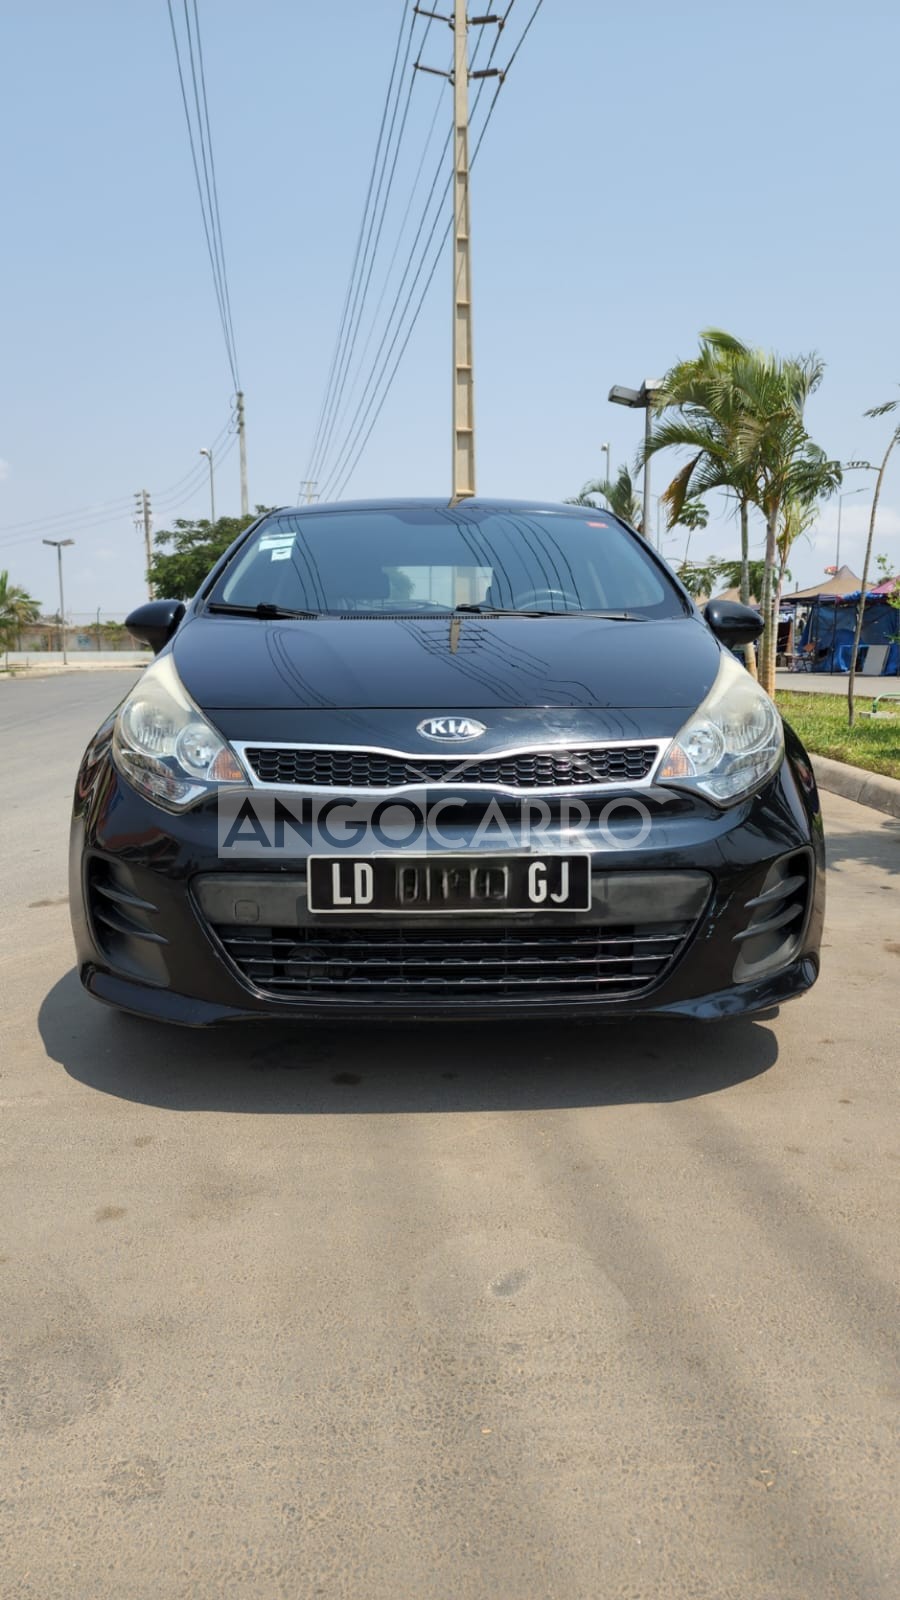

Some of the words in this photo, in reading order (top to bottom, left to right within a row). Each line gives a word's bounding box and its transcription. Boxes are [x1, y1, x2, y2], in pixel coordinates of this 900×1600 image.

[430, 719, 474, 736] KIA
[332, 862, 373, 905] LD
[528, 861, 570, 903] GJ
